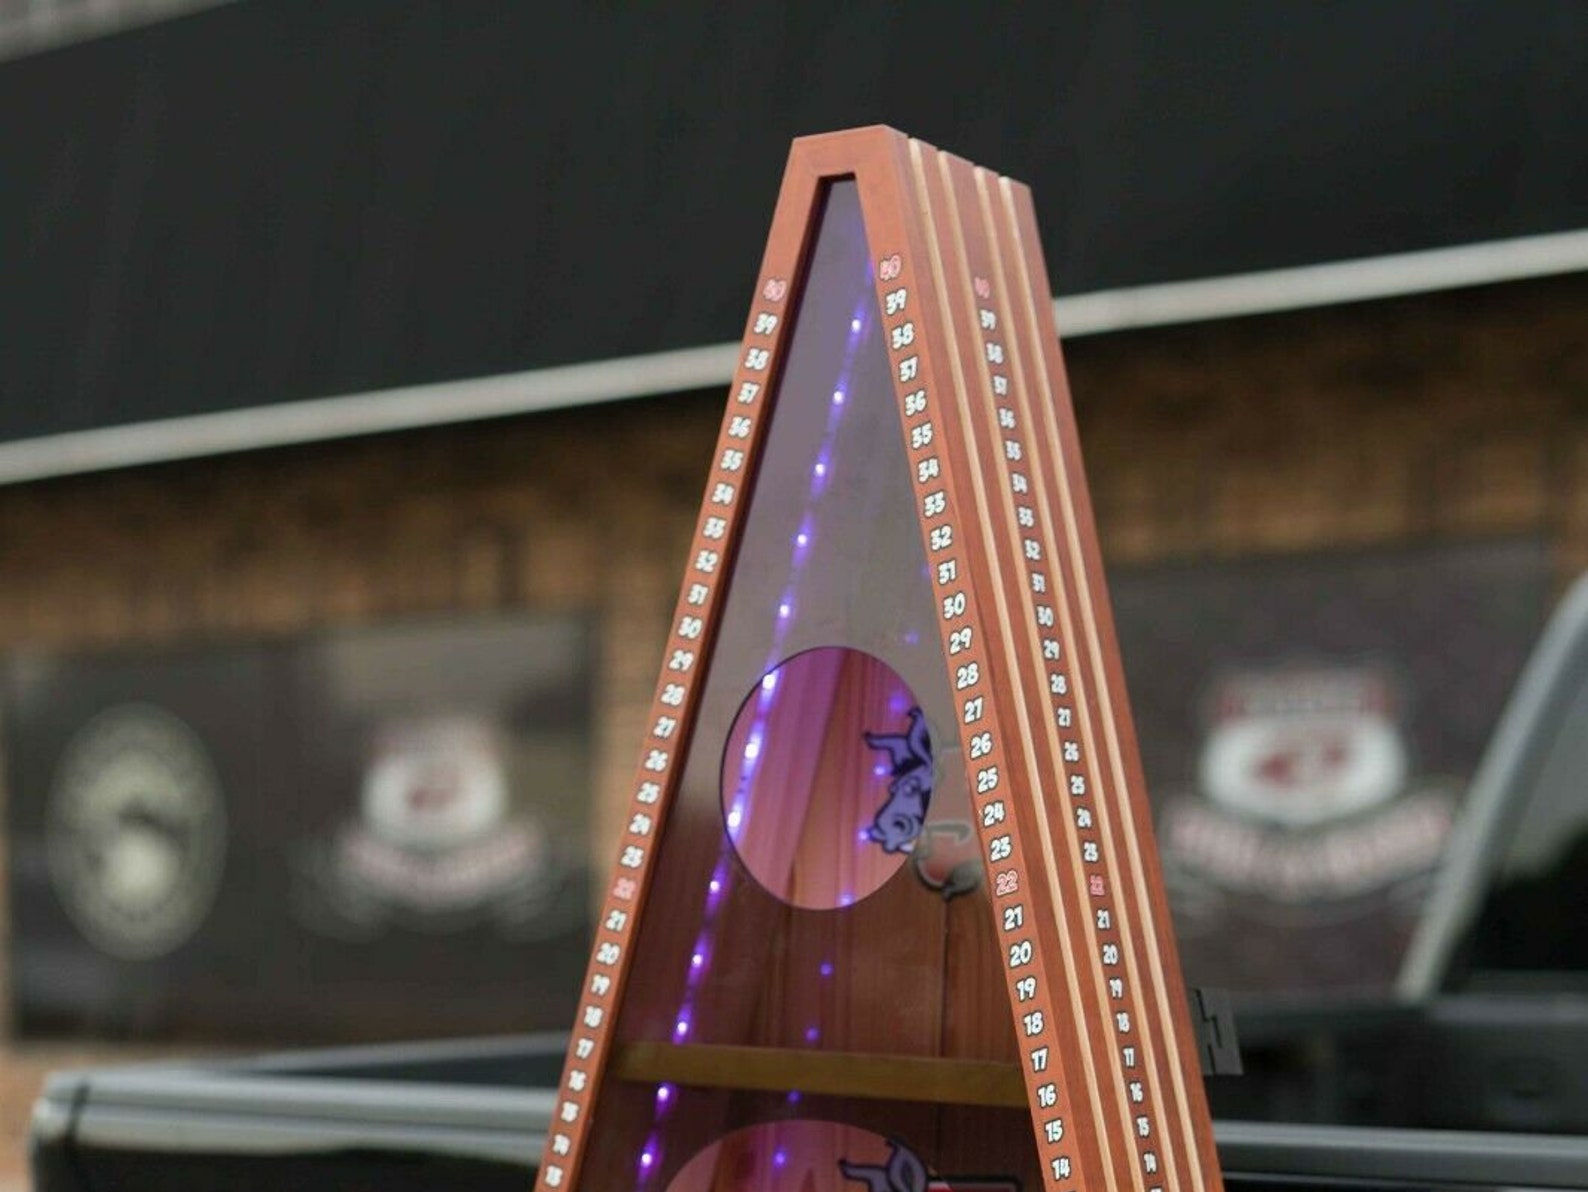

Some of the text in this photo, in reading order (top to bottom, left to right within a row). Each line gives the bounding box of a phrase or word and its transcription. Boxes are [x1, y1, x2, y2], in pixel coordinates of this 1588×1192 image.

[886, 289, 907, 315] 39
[892, 323, 914, 349] 38
[899, 356, 918, 382] 37
[905, 390, 926, 416] 36
[912, 423, 933, 449] 35
[918, 458, 939, 482] 34
[924, 491, 946, 517] 33
[930, 525, 952, 550] 32
[938, 560, 956, 584] 31
[943, 592, 966, 619] 30
[950, 627, 972, 654] 29
[957, 663, 979, 689] 28
[964, 697, 983, 723] 27
[971, 733, 992, 758] 26
[978, 767, 998, 793] 25
[984, 802, 1005, 826] 24
[991, 836, 1011, 861] 23
[996, 870, 1018, 896] 22
[1004, 906, 1023, 930] 21
[1010, 941, 1032, 967] 20
[1017, 977, 1036, 1000] 19
[1024, 1012, 1043, 1035] 18
[1031, 1048, 1048, 1071] 17
[1038, 1084, 1056, 1107] 16
[1045, 1119, 1063, 1142] 15
[1052, 1158, 1070, 1179] 14
